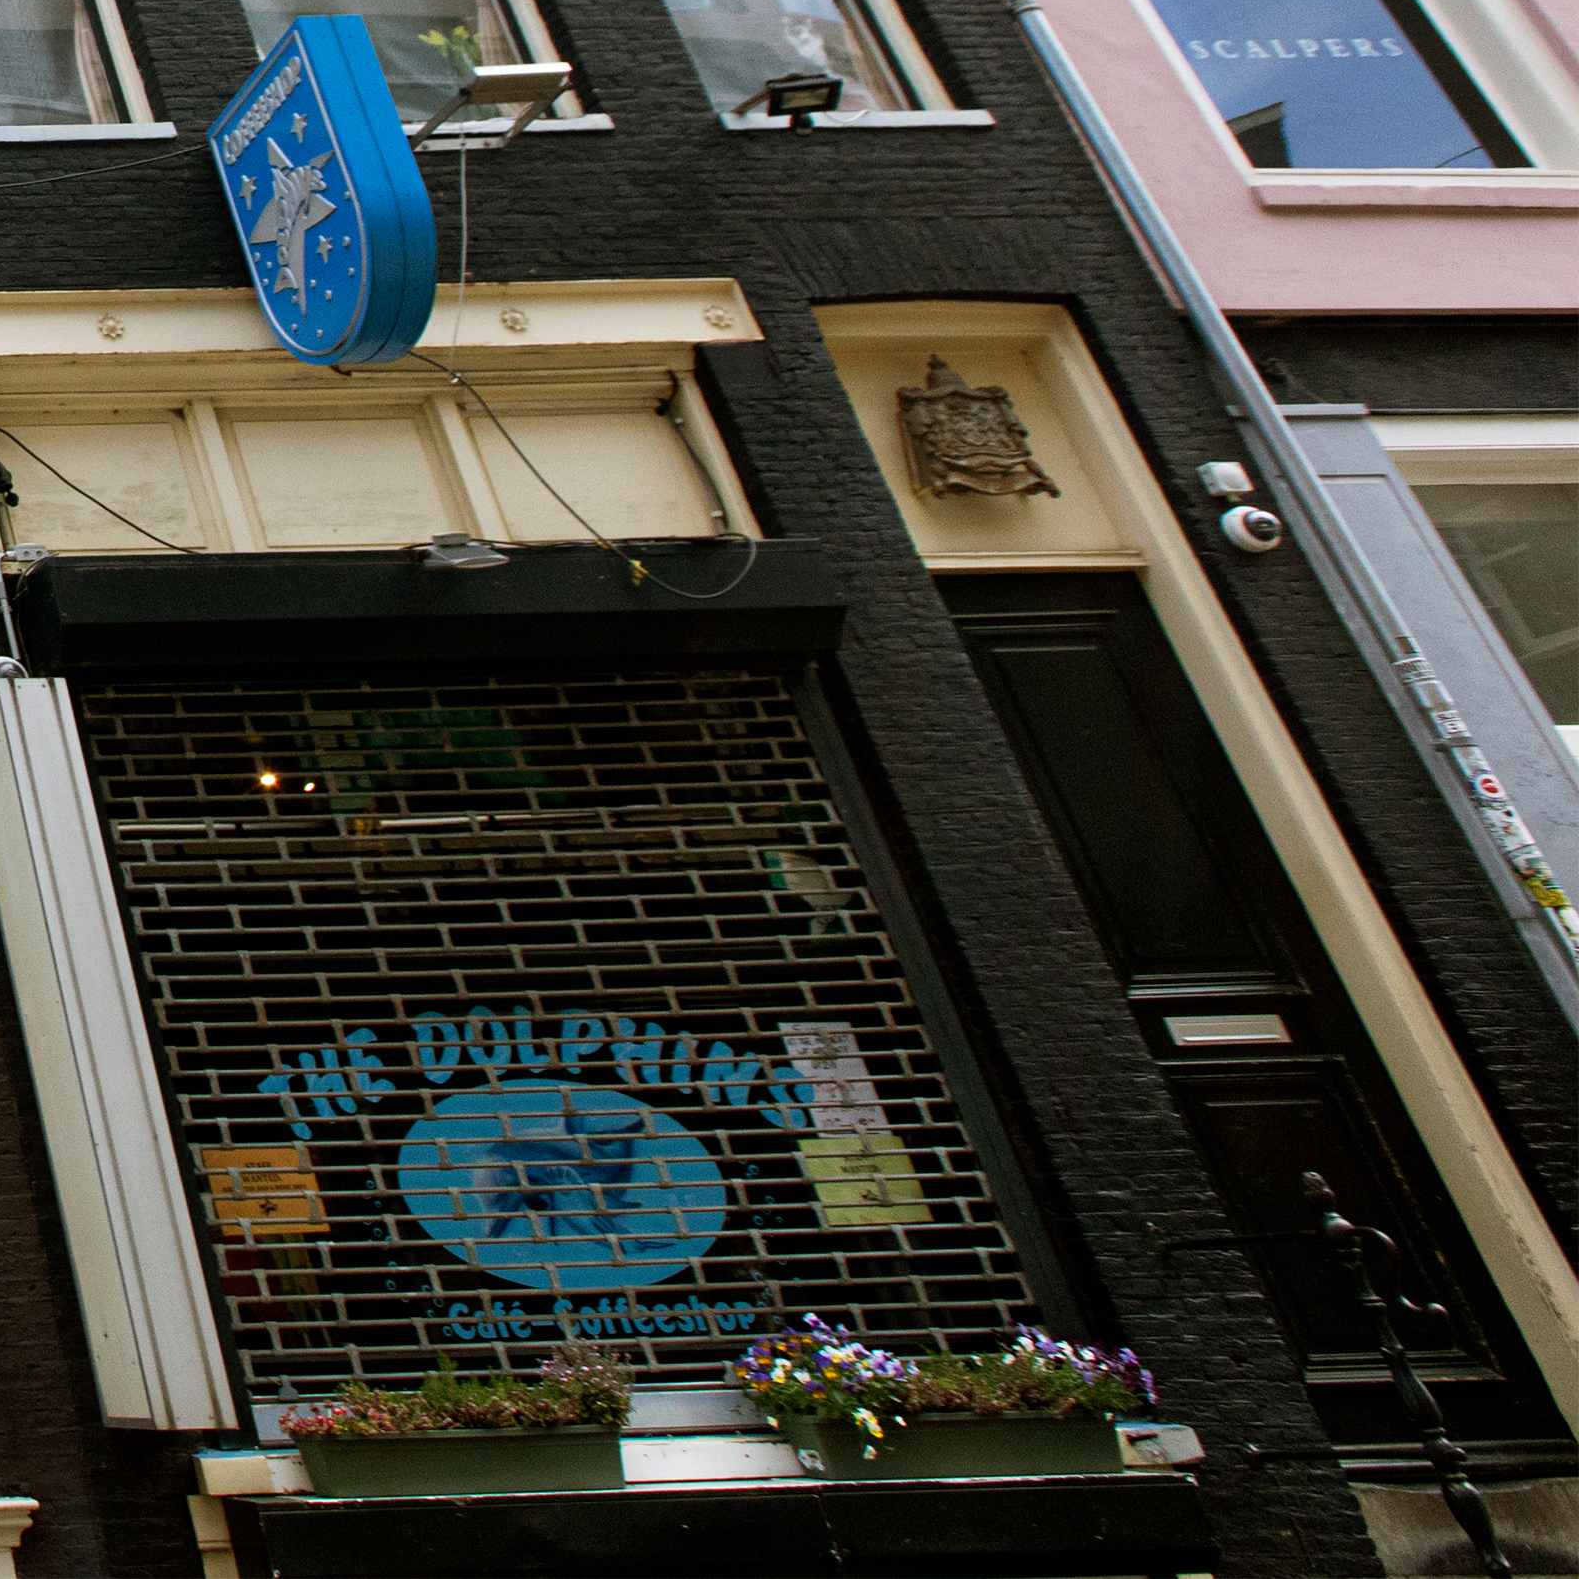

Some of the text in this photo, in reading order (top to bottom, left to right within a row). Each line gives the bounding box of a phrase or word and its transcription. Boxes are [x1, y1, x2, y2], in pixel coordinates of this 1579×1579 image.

[1189, 37, 1403, 59] SCALPERS
[257, 1005, 816, 1140] THE DOLPHINS
